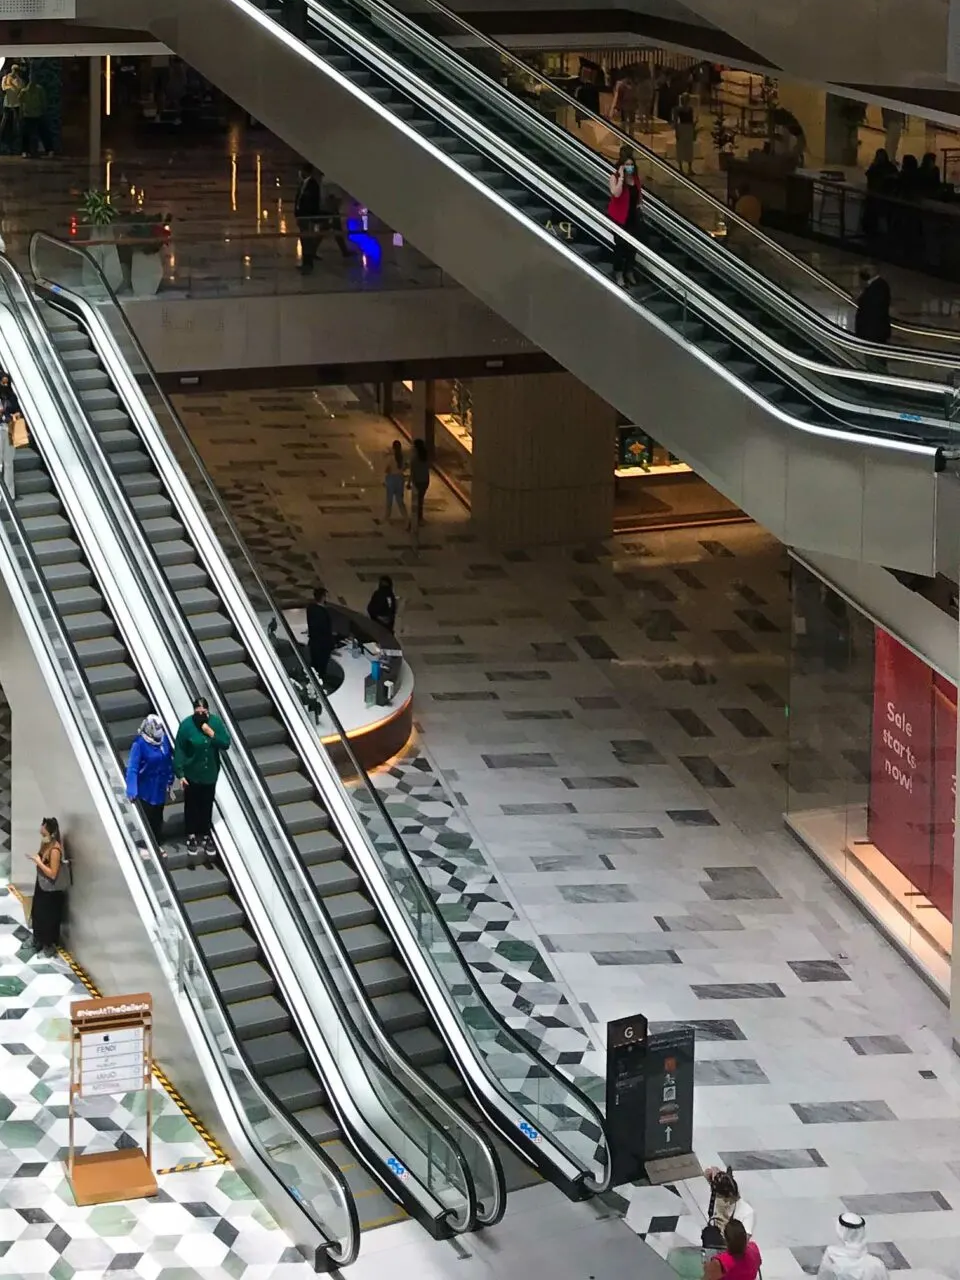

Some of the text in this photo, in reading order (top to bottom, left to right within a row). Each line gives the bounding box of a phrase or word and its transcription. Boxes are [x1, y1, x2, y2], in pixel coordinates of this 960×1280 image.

[887, 701, 913, 738] Sale
[882, 729, 917, 769] starts
[885, 759, 913, 794] now!
[624, 1026, 634, 1039] G
